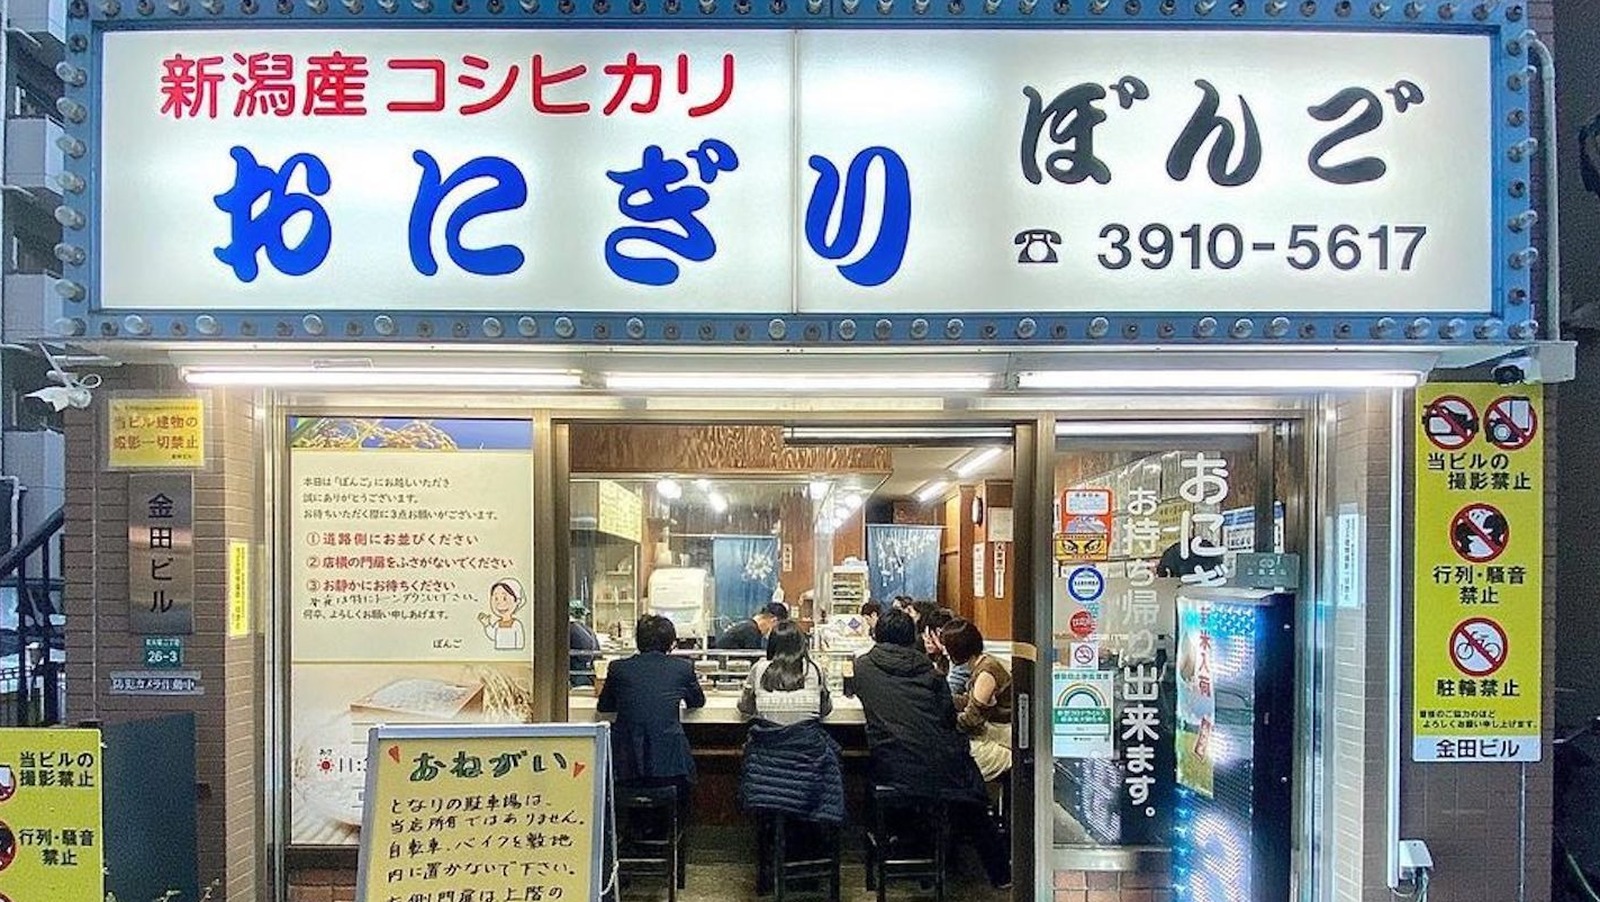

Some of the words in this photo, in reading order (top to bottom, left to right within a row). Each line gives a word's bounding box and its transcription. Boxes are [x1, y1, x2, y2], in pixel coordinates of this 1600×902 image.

[160, 50, 735, 119] 新潟産コシヒカリ
[1020, 75, 1425, 188] ぼんご
[213, 138, 912, 288] おにぎり
[1097, 222, 1428, 272] 3910-5617
[1428, 452, 1509, 471] 当ビルの
[1448, 472, 1532, 490] 撮影禁止
[148, 492, 174, 614] 金田ビル
[1459, 586, 1499, 604] 禁止
[148, 651, 178, 662] 26-3
[1437, 679, 1520, 697] 駐輪禁止
[1436, 739, 1520, 758] 金田ビル
[19, 752, 94, 768] 当ビルの
[340, 757, 367, 772] 11:
[409, 750, 567, 782] おねがい
[19, 770, 94, 787] 撮影禁止
[42, 850, 78, 866] 禁止
